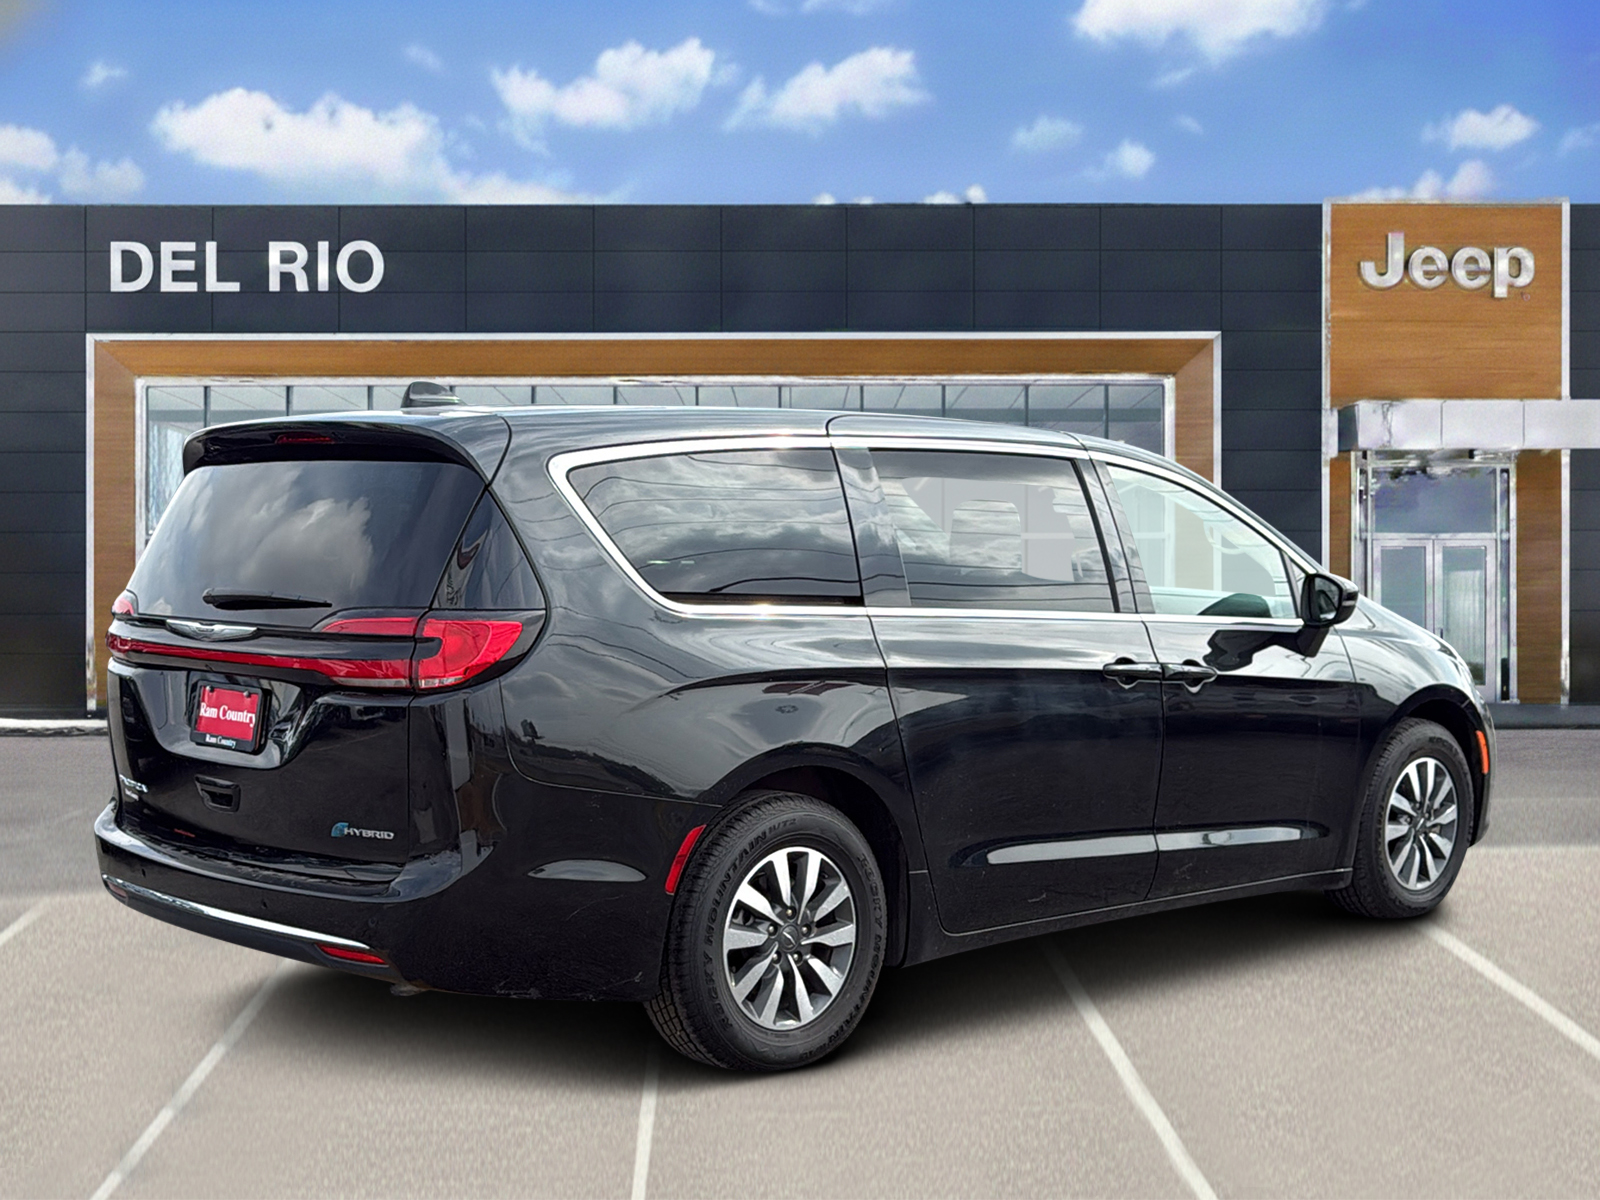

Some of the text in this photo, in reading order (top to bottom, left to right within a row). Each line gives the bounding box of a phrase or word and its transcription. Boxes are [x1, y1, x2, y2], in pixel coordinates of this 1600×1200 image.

[110, 240, 384, 293] DEL RIO
[1360, 231, 1535, 298] Jeep
[199, 702, 256, 728] Ram Country
[344, 827, 395, 840] HYBRID
